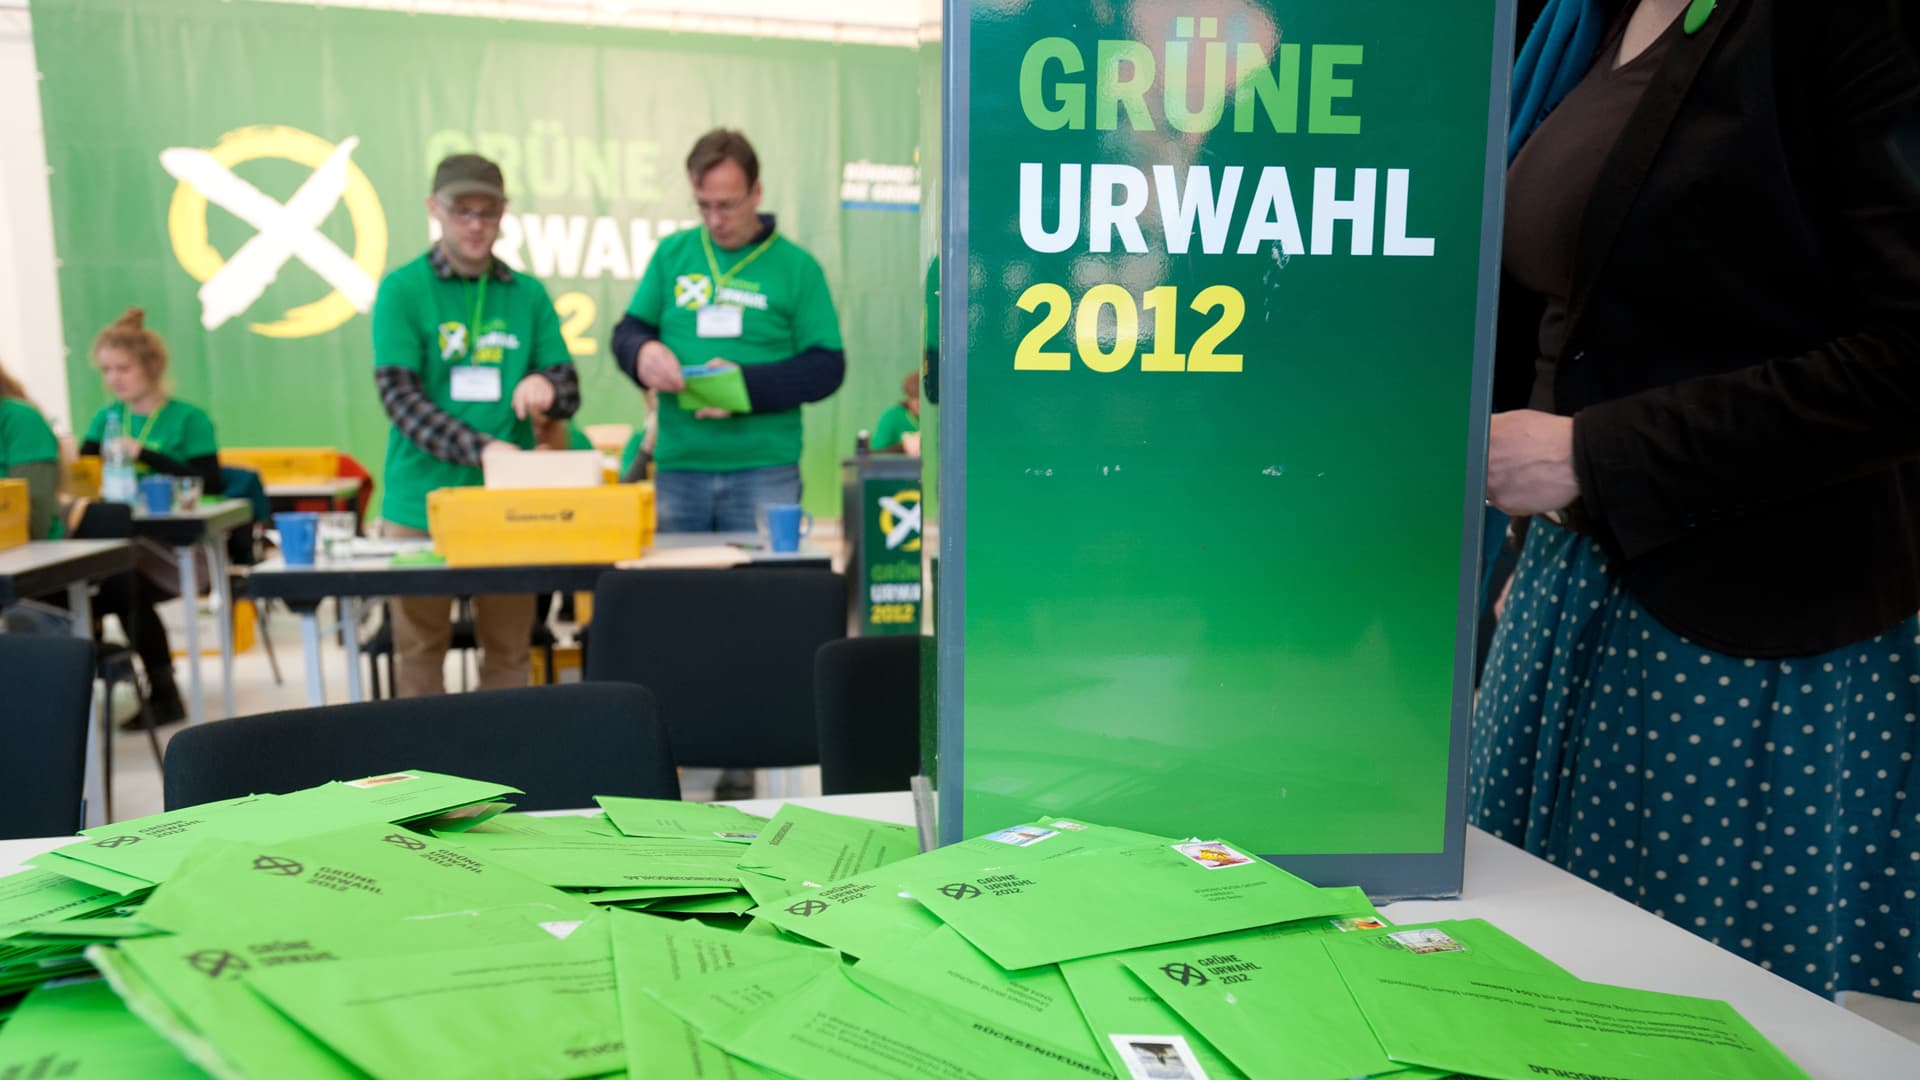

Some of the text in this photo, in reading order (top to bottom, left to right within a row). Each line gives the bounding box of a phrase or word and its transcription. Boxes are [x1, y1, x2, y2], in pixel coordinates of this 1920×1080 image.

[1019, 16, 1364, 135] GRÜNE
[1019, 162, 1436, 257] URWAHL
[428, 212, 699, 280] RWAH
[1013, 283, 1246, 373] 2012
[870, 603, 915, 624] 2012
[427, 851, 483, 874] URWAHL
[437, 849, 484, 867] GRÜNE
[312, 871, 384, 896] URWAHL
[319, 866, 377, 884] GRÜNE
[976, 874, 1021, 885] GRÜNE
[818, 883, 858, 897] GRÜNE
[827, 884, 877, 900] URWAHL
[983, 879, 1038, 890] URWAHL
[992, 887, 1025, 896] 2012
[837, 892, 867, 904] 2012
[1197, 954, 1243, 967] GRÜNE
[1207, 961, 1263, 975] URWAHL
[1218, 973, 1253, 985] 2012
